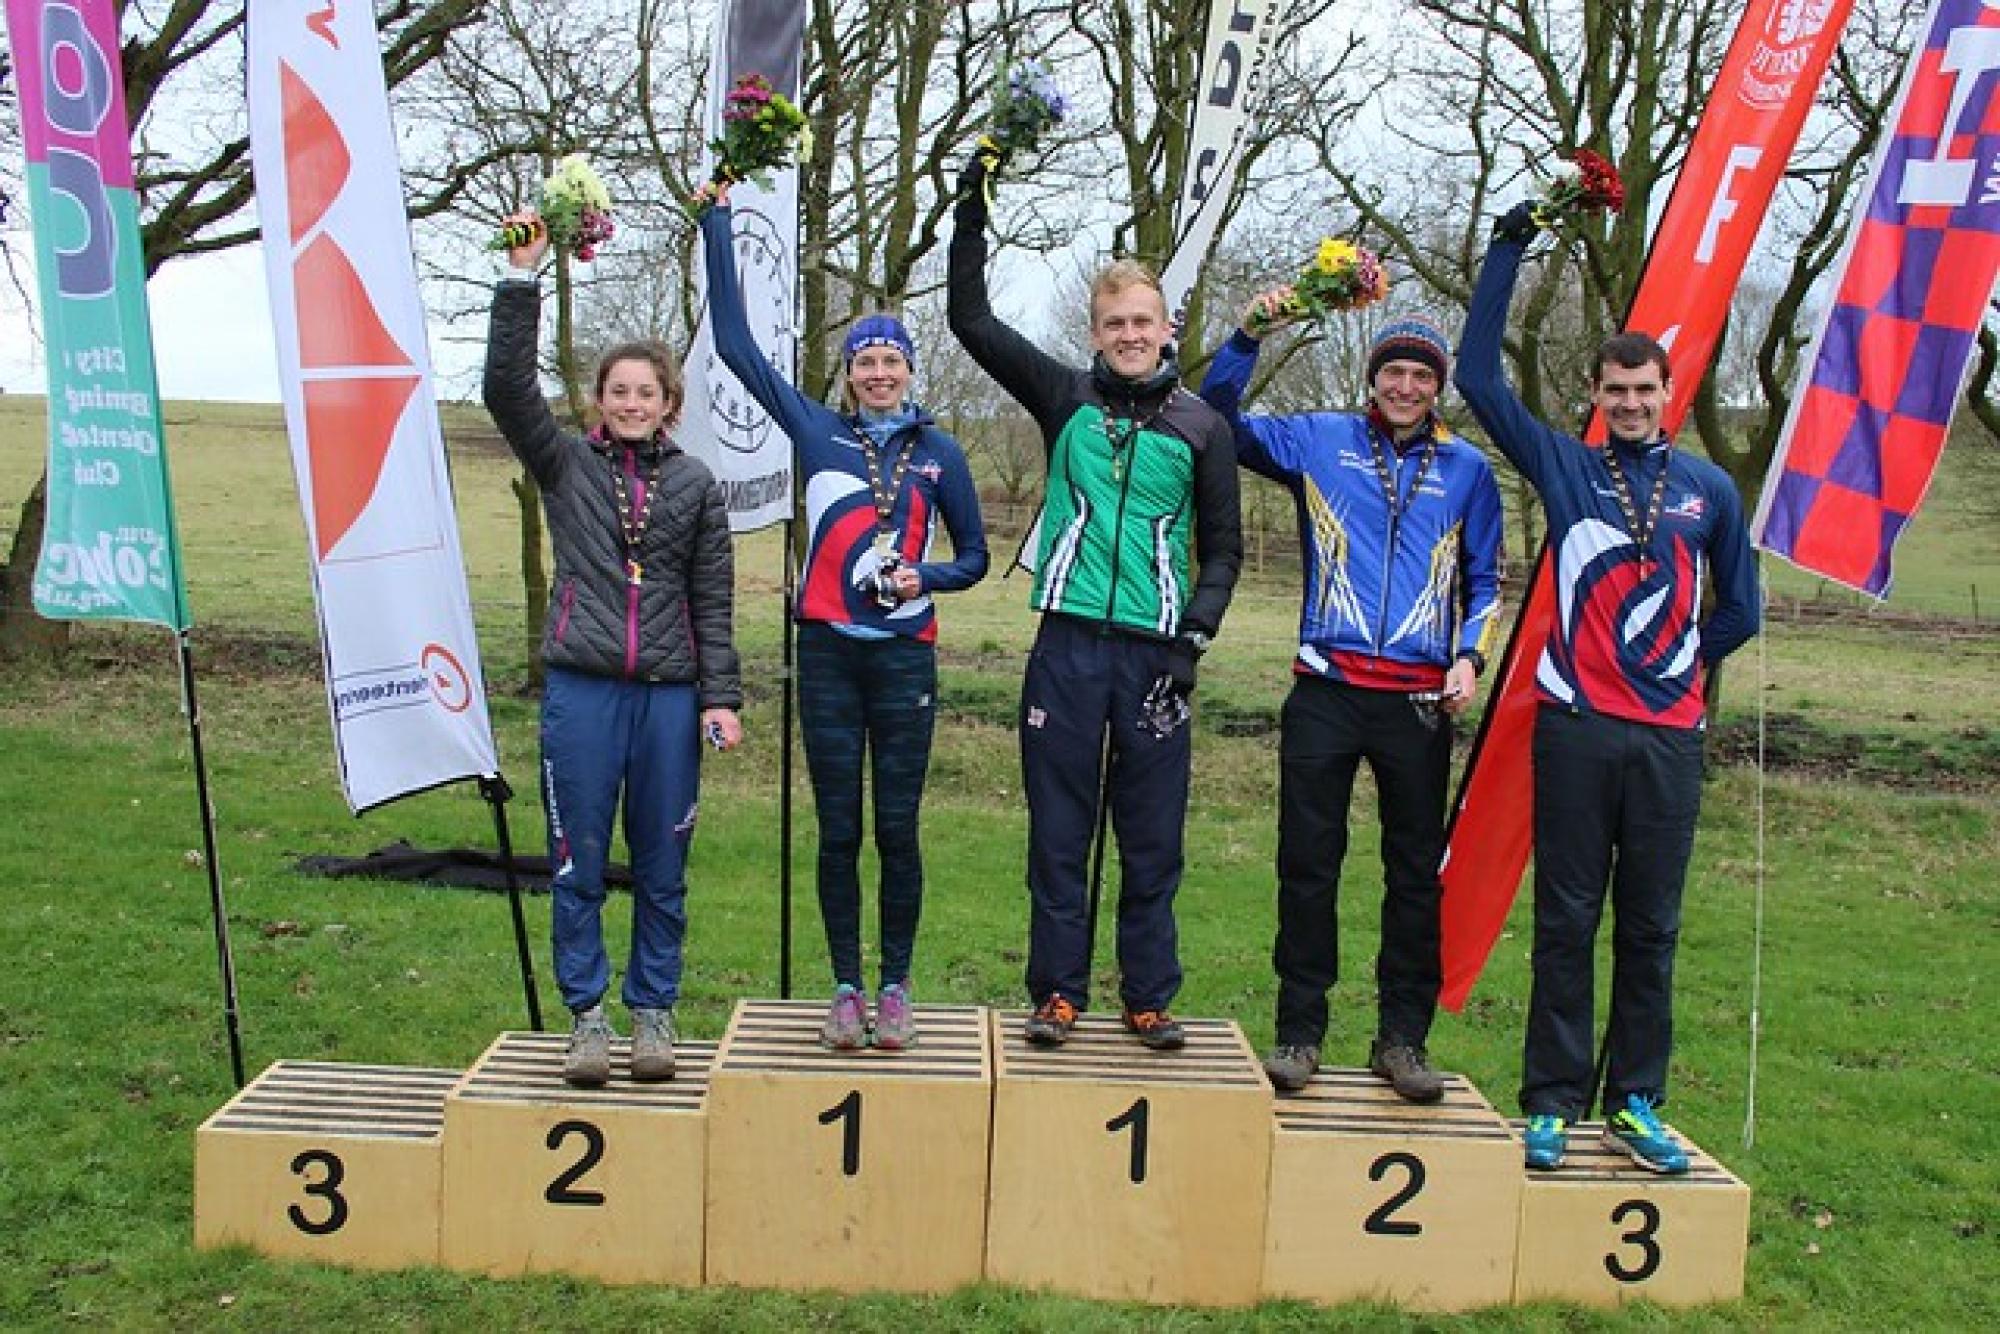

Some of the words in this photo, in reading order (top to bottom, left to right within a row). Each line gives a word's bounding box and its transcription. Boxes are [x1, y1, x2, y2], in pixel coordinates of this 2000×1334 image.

[544, 1121, 606, 1207] 2
[819, 1090, 863, 1176] 1
[1106, 1097, 1148, 1184] 1
[288, 1150, 348, 1235] 3
[1364, 1153, 1425, 1235] 2
[1604, 1200, 1661, 1282] 3
